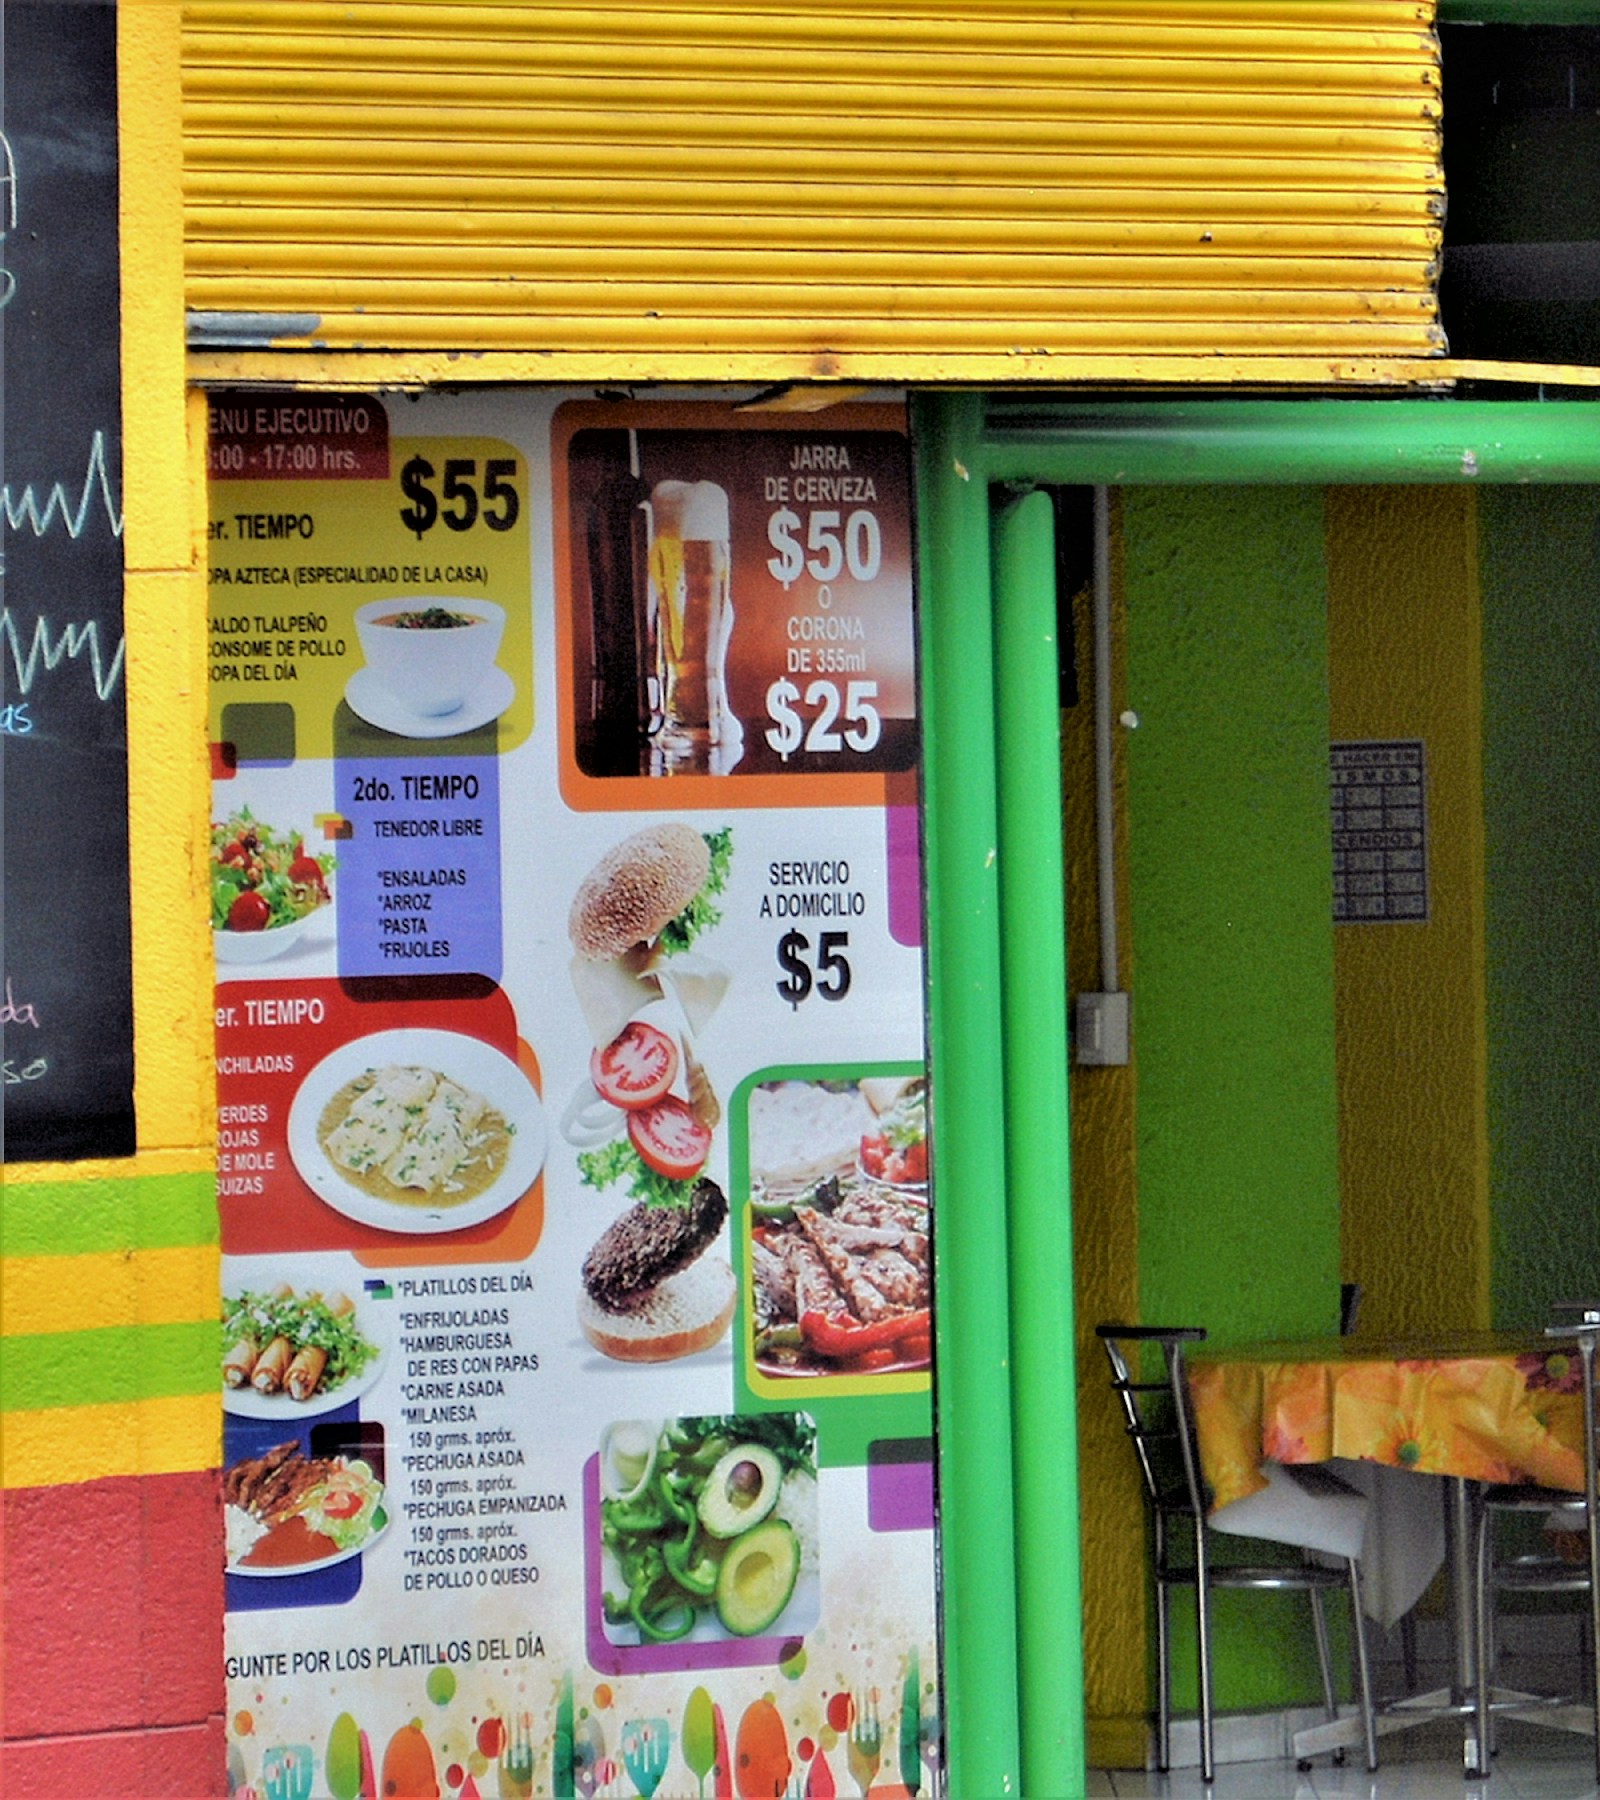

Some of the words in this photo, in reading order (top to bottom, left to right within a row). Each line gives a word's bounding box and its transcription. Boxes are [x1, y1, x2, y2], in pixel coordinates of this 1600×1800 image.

[255, 407, 369, 434] EJECUTIVO
[264, 444, 316, 470] 17:00
[324, 443, 361, 470] hrs.
[789, 446, 850, 471] JARRA
[400, 454, 520, 541] $55
[765, 477, 789, 502] DE
[793, 476, 878, 502] CERVEZA
[235, 514, 314, 540] TIEMPO
[767, 505, 881, 590] $50
[235, 567, 290, 585] AZTECA
[294, 566, 399, 588] (ESPECIALIDAD
[402, 567, 421, 584] DE
[425, 566, 442, 583] LA
[445, 565, 488, 587] CASA)
[818, 584, 832, 609] O
[208, 616, 250, 634] ALDO
[254, 612, 328, 633] TLALPEÑO
[787, 616, 865, 641] CORONA
[208, 640, 272, 658] ONSOME
[276, 640, 296, 657] DE
[300, 639, 347, 657] POLLO
[787, 648, 812, 673] DE
[815, 647, 867, 673] 355ml
[244, 664, 270, 681] DEL
[274, 660, 298, 681] DÍA
[765, 676, 882, 763] $25
[353, 777, 395, 802] 2do.
[401, 775, 479, 800] TIEMPO
[373, 820, 440, 838] TENEDOR
[443, 819, 483, 837] LIBRE
[769, 861, 850, 886] SERVICIO
[760, 895, 772, 918] A
[776, 892, 865, 918] DOMICILIO
[776, 927, 852, 1012] $5
[244, 998, 325, 1026] TIEMPO
[216, 1104, 269, 1124] ERDES
[235, 1151, 275, 1171] MOLE
[480, 1277, 507, 1294] DEL
[511, 1270, 533, 1292] DÍA
[407, 1360, 426, 1377] DE
[430, 1359, 458, 1376] RES
[462, 1357, 491, 1374] CON
[494, 1354, 539, 1373] PAPAS
[457, 1380, 505, 1399] ASADA
[408, 1431, 431, 1450] 150
[477, 1450, 525, 1468] ASADA
[410, 1478, 432, 1497] 150
[479, 1494, 567, 1515] EMPANIZADA
[410, 1526, 433, 1544] 150
[459, 1544, 528, 1564] DORADOS
[404, 1573, 423, 1591] DE
[427, 1569, 473, 1590] POLLO
[477, 1569, 488, 1587] O
[491, 1566, 540, 1587] QUESO
[292, 1650, 331, 1674] POR
[335, 1647, 372, 1671] LOS
[377, 1640, 472, 1669] PLATILLOS
[477, 1637, 512, 1662] DEL
[515, 1631, 546, 1660] DÍA
